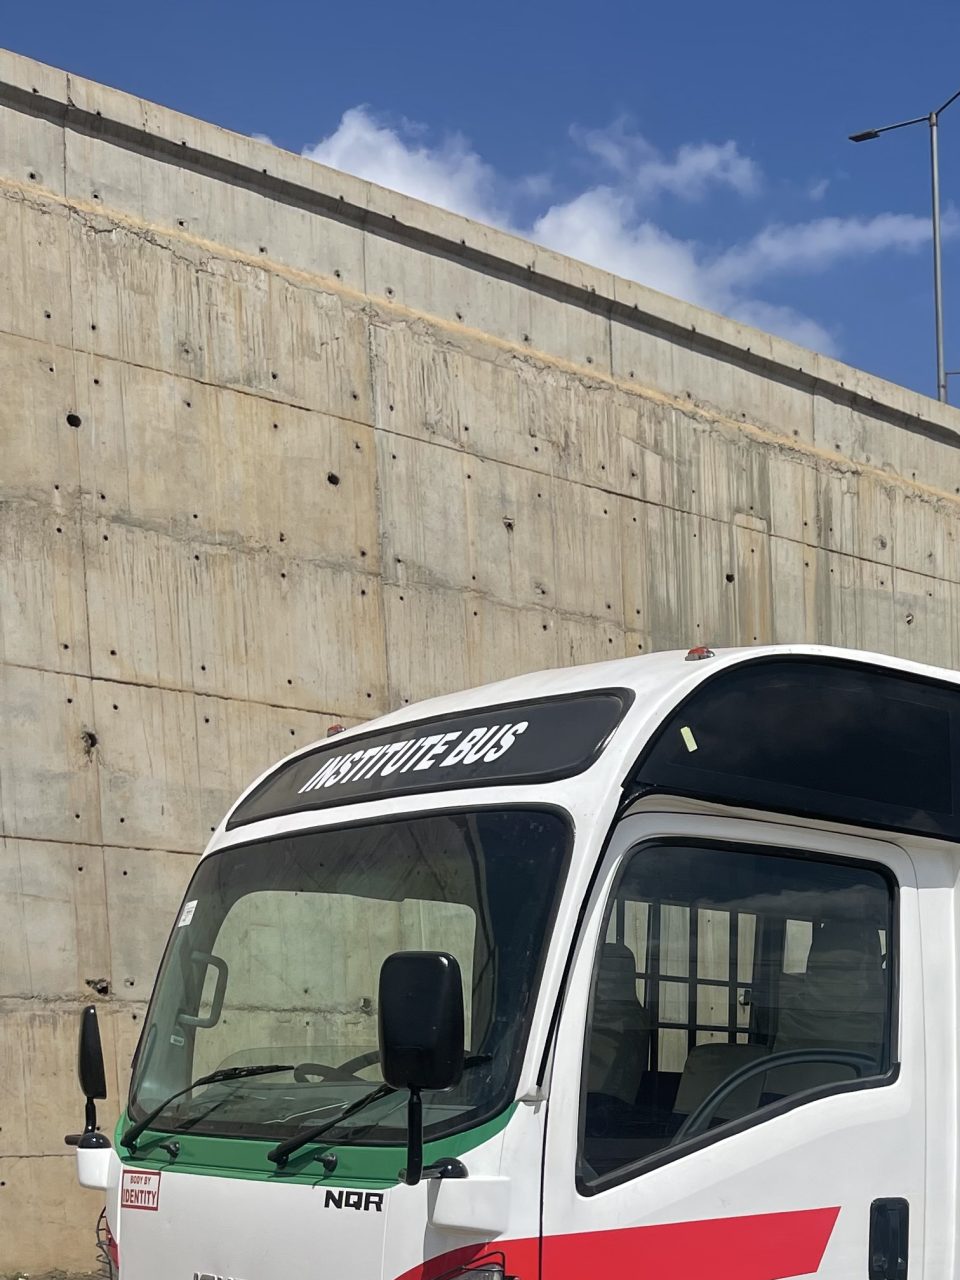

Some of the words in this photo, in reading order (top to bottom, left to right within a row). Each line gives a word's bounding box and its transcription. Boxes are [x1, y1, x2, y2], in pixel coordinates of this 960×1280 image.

[298, 731, 456, 794] INSTITUTE
[445, 721, 529, 768] BUS
[129, 1175, 142, 1185] BODY
[143, 1176, 152, 1186] BY
[123, 1188, 157, 1206] IDENTITY
[324, 1190, 384, 1212] NQR
